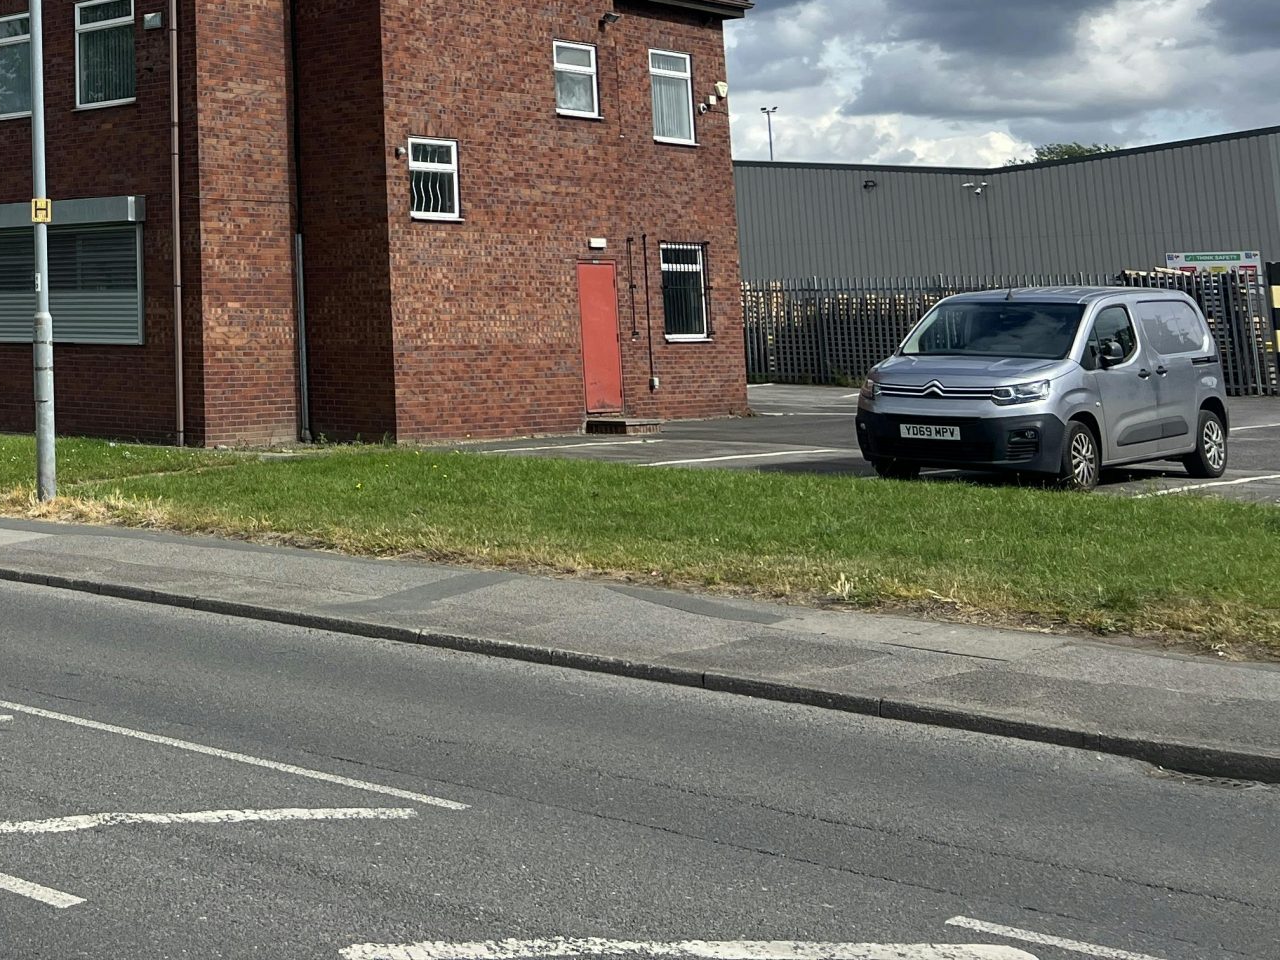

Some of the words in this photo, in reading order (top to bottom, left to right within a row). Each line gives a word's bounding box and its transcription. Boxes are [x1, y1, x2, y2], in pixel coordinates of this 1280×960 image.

[35, 200, 48, 218] H
[905, 426, 932, 436] YD69
[934, 427, 954, 438] MPV
